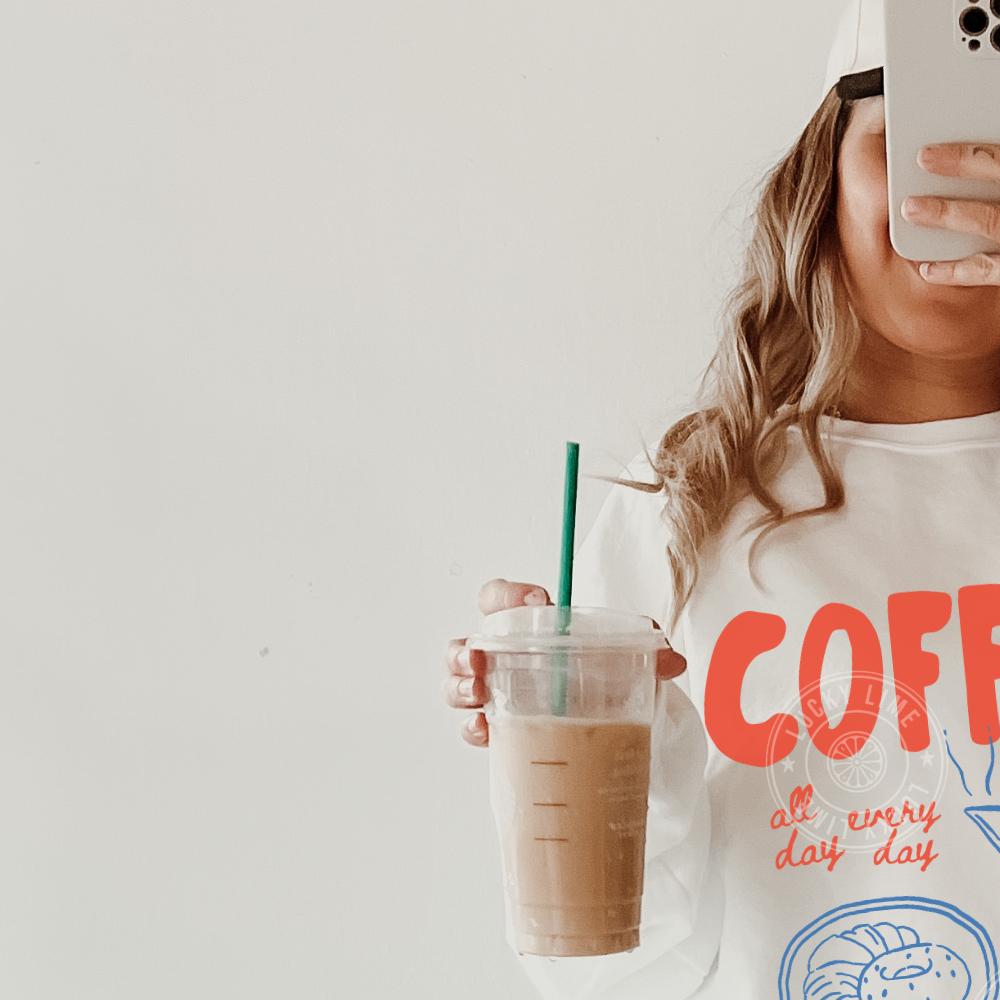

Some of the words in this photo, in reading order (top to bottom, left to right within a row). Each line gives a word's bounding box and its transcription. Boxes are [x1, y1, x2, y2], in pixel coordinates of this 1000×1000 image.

[770, 784, 817, 830] all
[848, 800, 941, 833] every
[775, 829, 845, 872] day
[873, 828, 939, 872] day
